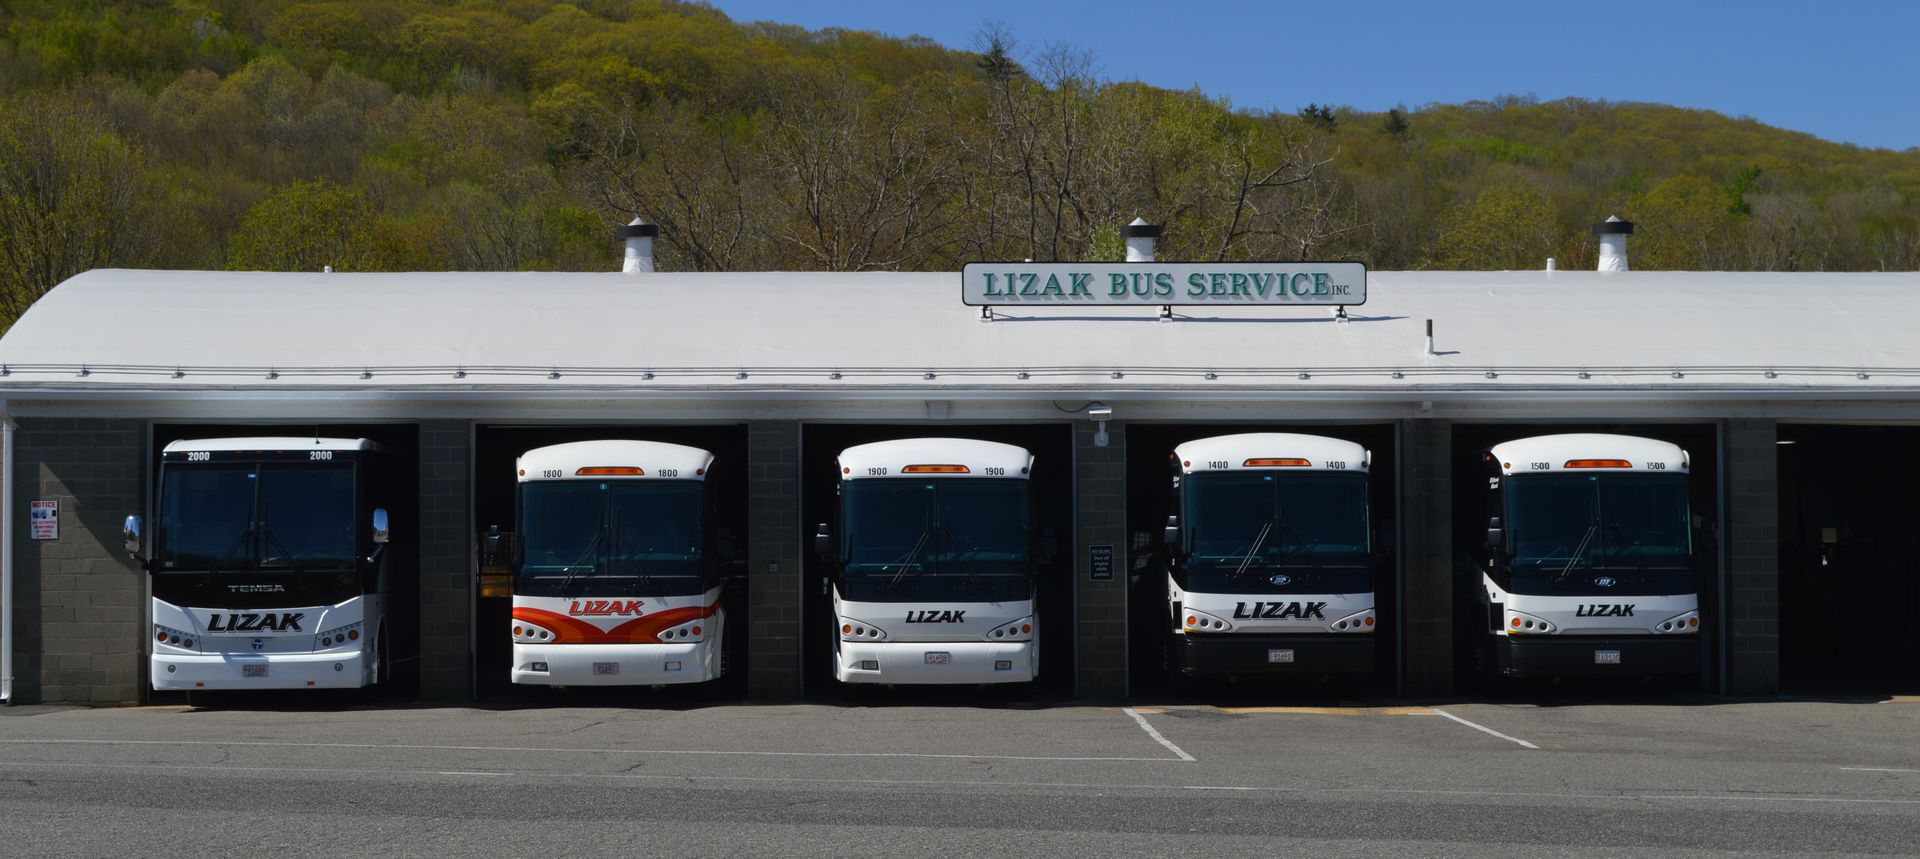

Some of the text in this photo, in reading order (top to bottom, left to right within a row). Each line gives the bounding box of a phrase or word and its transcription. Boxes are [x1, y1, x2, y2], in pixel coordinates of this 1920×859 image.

[983, 272, 1352, 297] LIZAK BUS SERVICE INC.
[188, 452, 210, 461] 2000
[310, 451, 332, 460] 2000
[1208, 461, 1229, 469] 1400
[1325, 461, 1346, 469] 1400
[1531, 462, 1550, 470] 1500
[1646, 462, 1666, 470] 1500
[543, 469, 562, 478] 1800
[658, 469, 678, 478] 1800
[868, 467, 888, 476] 1900
[985, 467, 1005, 476] 1900
[227, 584, 286, 593] TEMSA
[569, 600, 645, 616] LIZAK
[1232, 602, 1328, 621] LIZAK
[1575, 604, 1636, 617] LIZAK
[905, 610, 967, 624] LIZAK
[207, 612, 305, 633] LIZAK
